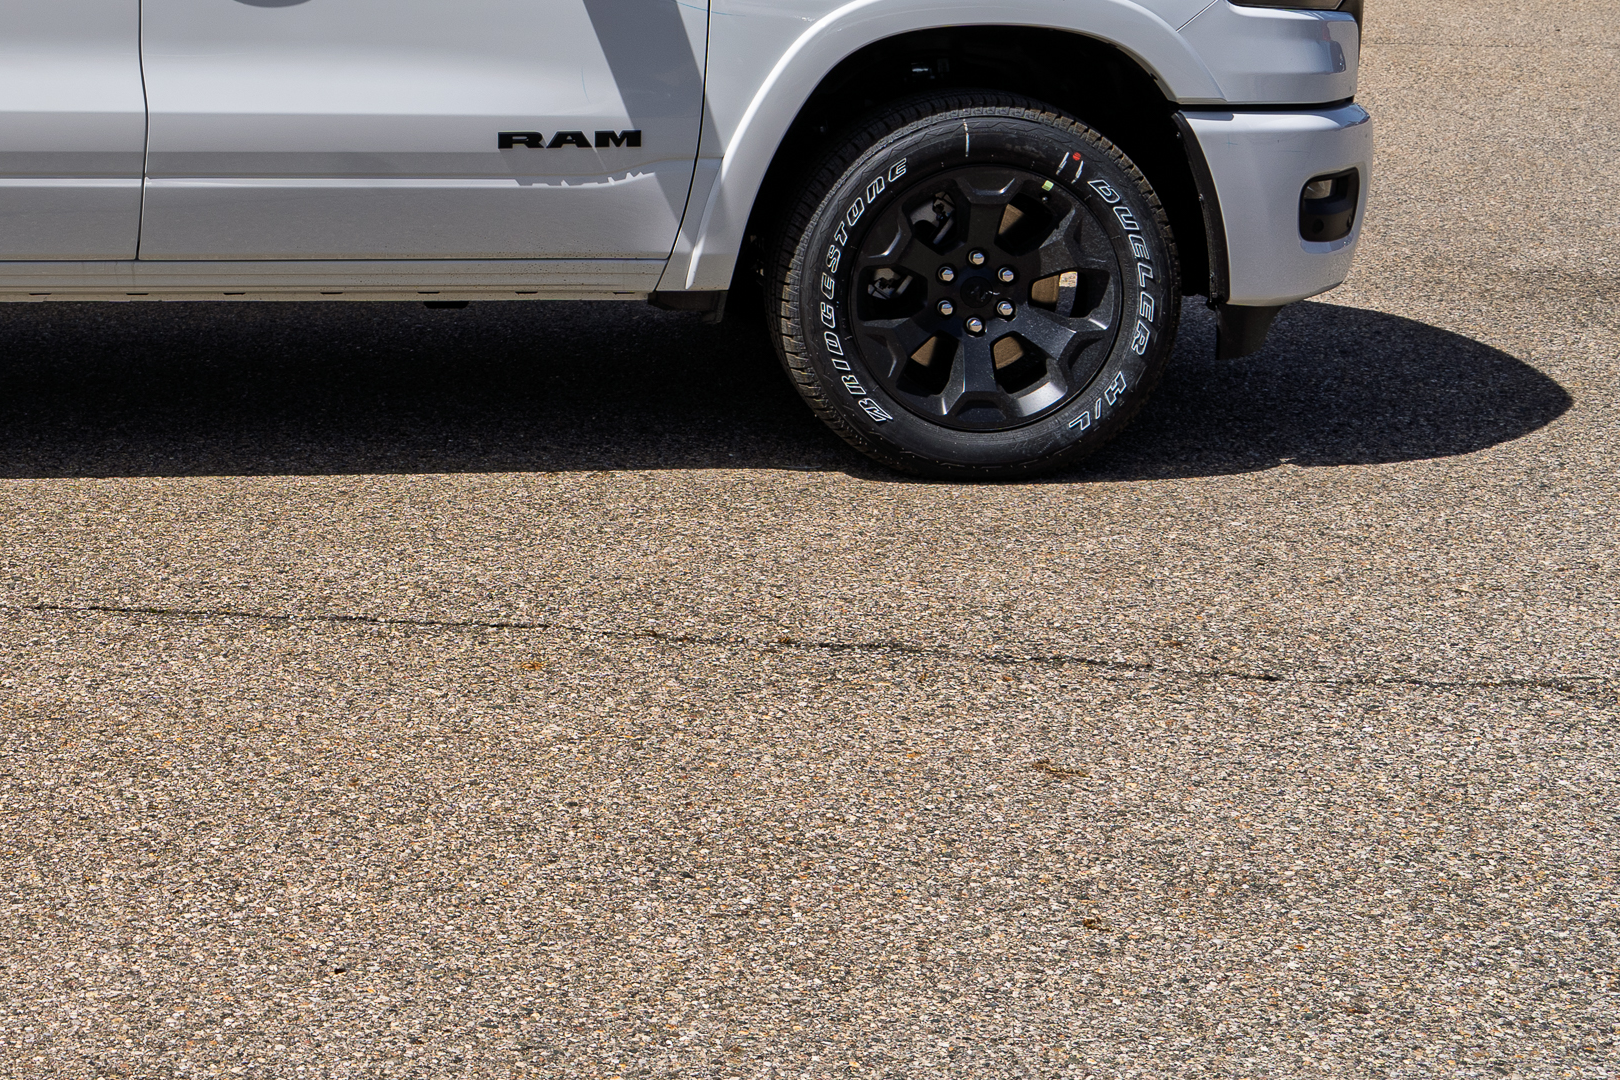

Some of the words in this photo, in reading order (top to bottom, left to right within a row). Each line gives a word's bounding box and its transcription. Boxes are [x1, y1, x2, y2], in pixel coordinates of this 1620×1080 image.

[498, 130, 642, 149] RAM
[820, 158, 907, 423] BRIDGESTONE
[1087, 179, 1154, 356] DUELER
[1068, 372, 1127, 431] H/L
